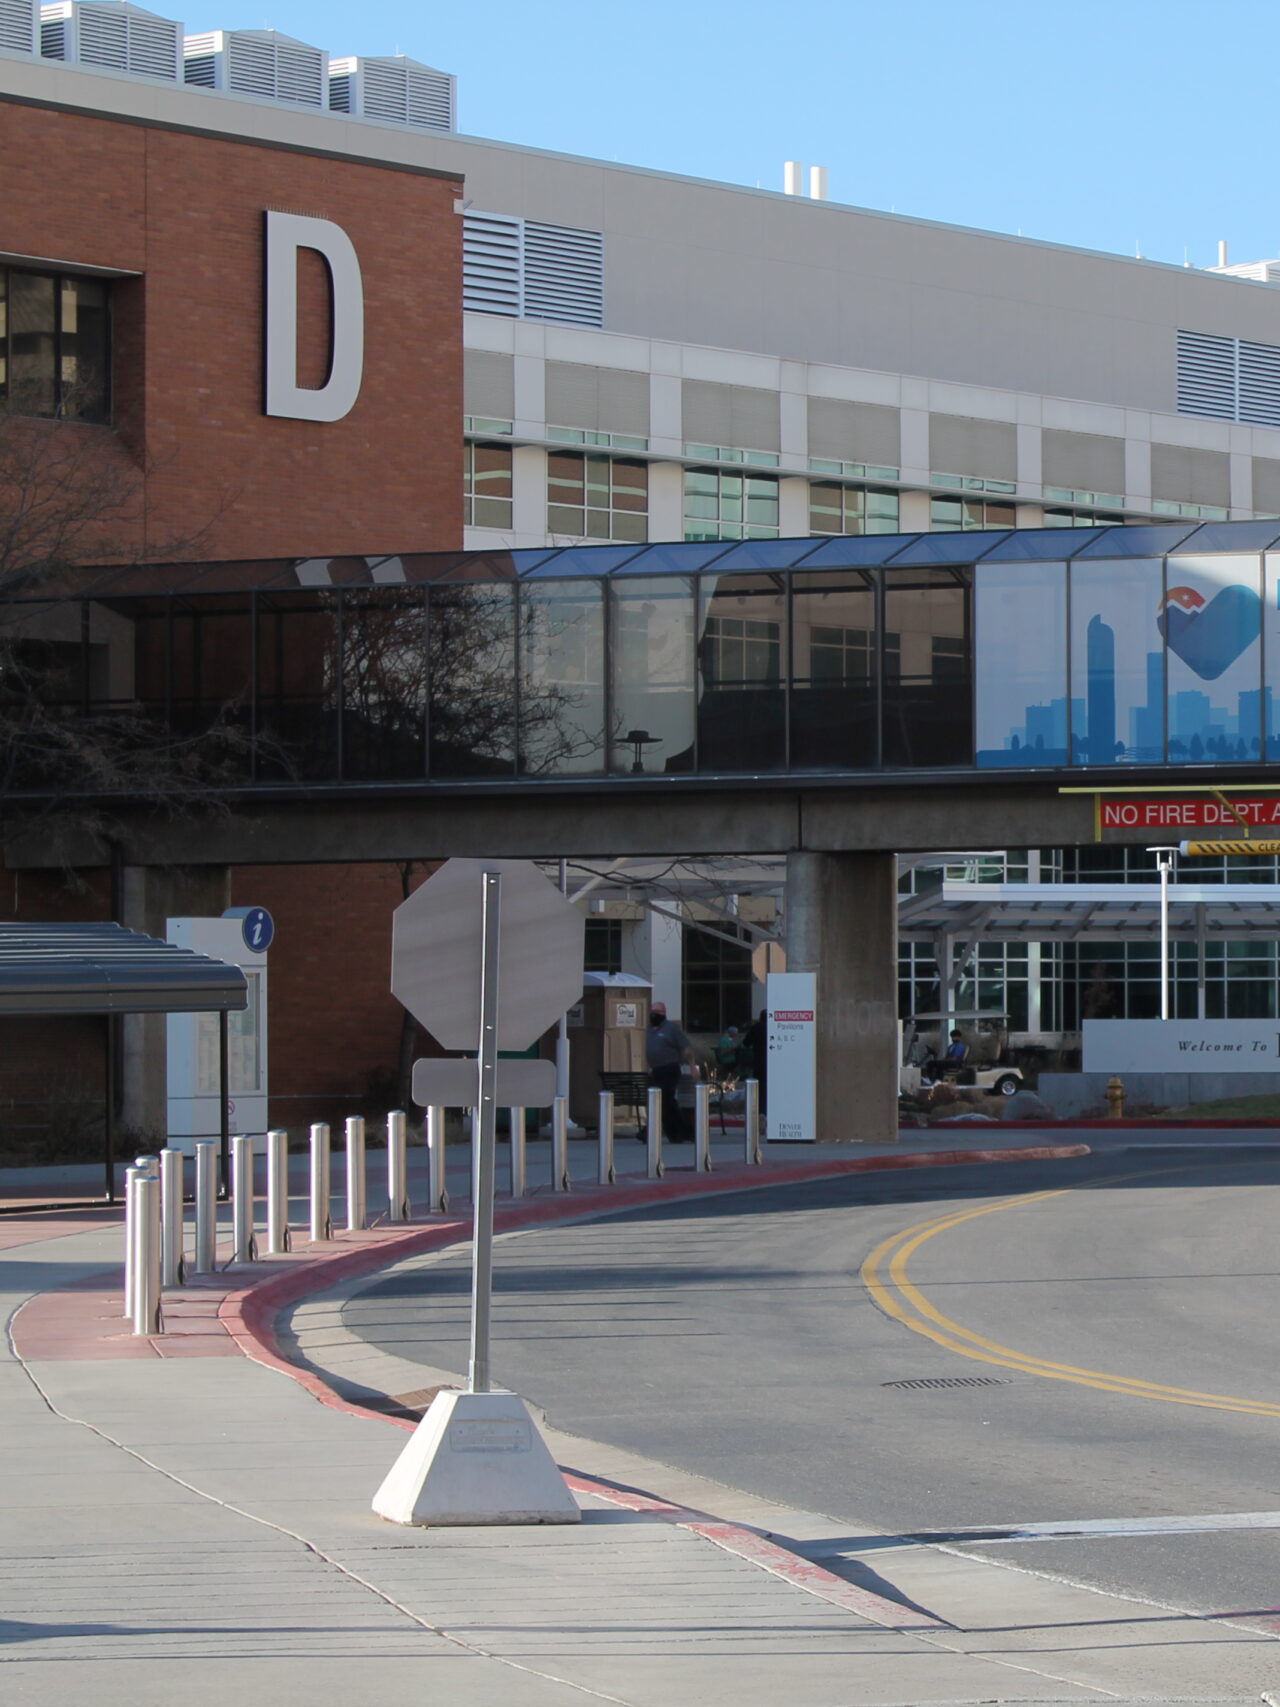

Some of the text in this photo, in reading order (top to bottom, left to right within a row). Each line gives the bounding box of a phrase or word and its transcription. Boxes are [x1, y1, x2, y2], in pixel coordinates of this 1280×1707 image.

[264, 210, 364, 422] D
[1105, 805, 1139, 824] NO
[1146, 804, 1196, 823] FIRE
[1204, 803, 1266, 823] DEPT.
[775, 1012, 812, 1020] EMERGENCY
[1178, 1041, 1243, 1052] Welcome
[1252, 1041, 1267, 1052] To
